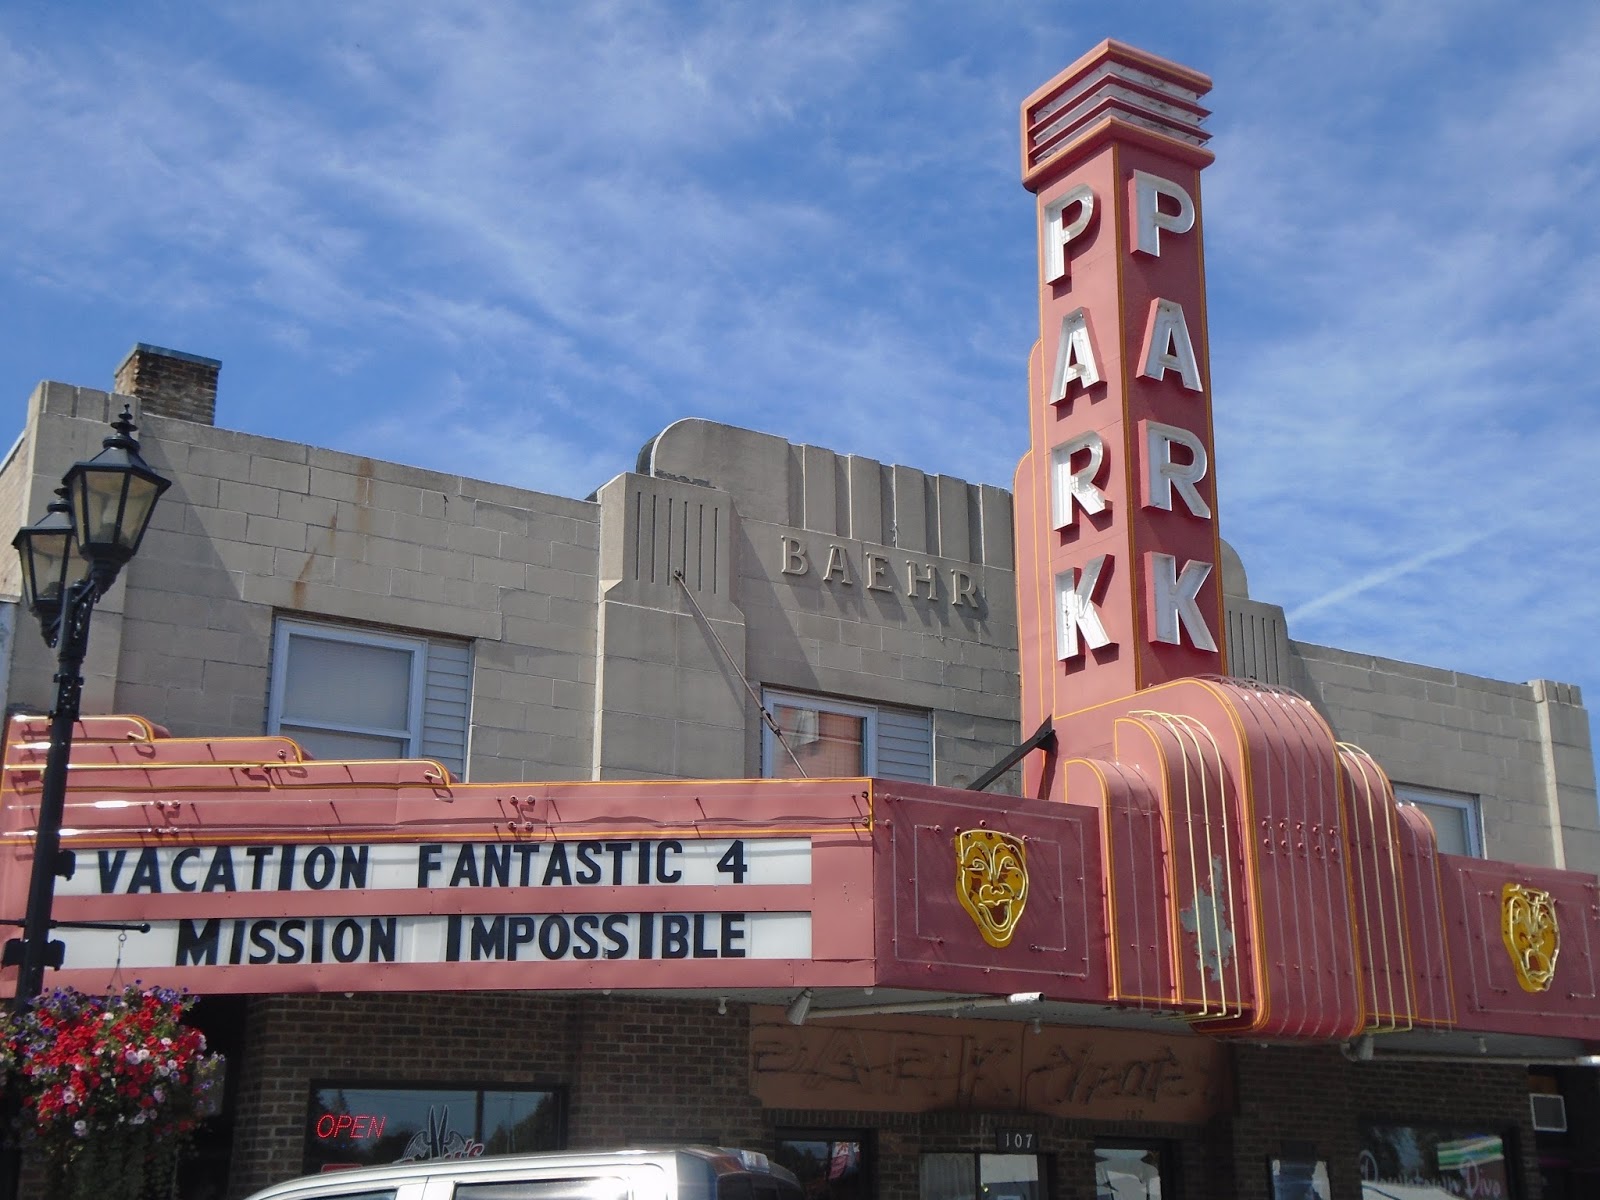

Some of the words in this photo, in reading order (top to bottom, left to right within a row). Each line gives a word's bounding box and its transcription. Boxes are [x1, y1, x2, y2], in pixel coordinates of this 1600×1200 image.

[1044, 183, 1116, 662] PARK
[1128, 168, 1219, 653] PARK
[780, 535, 980, 608] BAEHR
[97, 843, 369, 895] VACATION
[417, 840, 683, 888] FANTASTIC
[716, 839, 748, 884] 4
[175, 917, 397, 967] MISSION
[446, 912, 747, 962] IMPOSSIBLE
[316, 1113, 387, 1139] OPEN
[1005, 1133, 1034, 1149] 107
